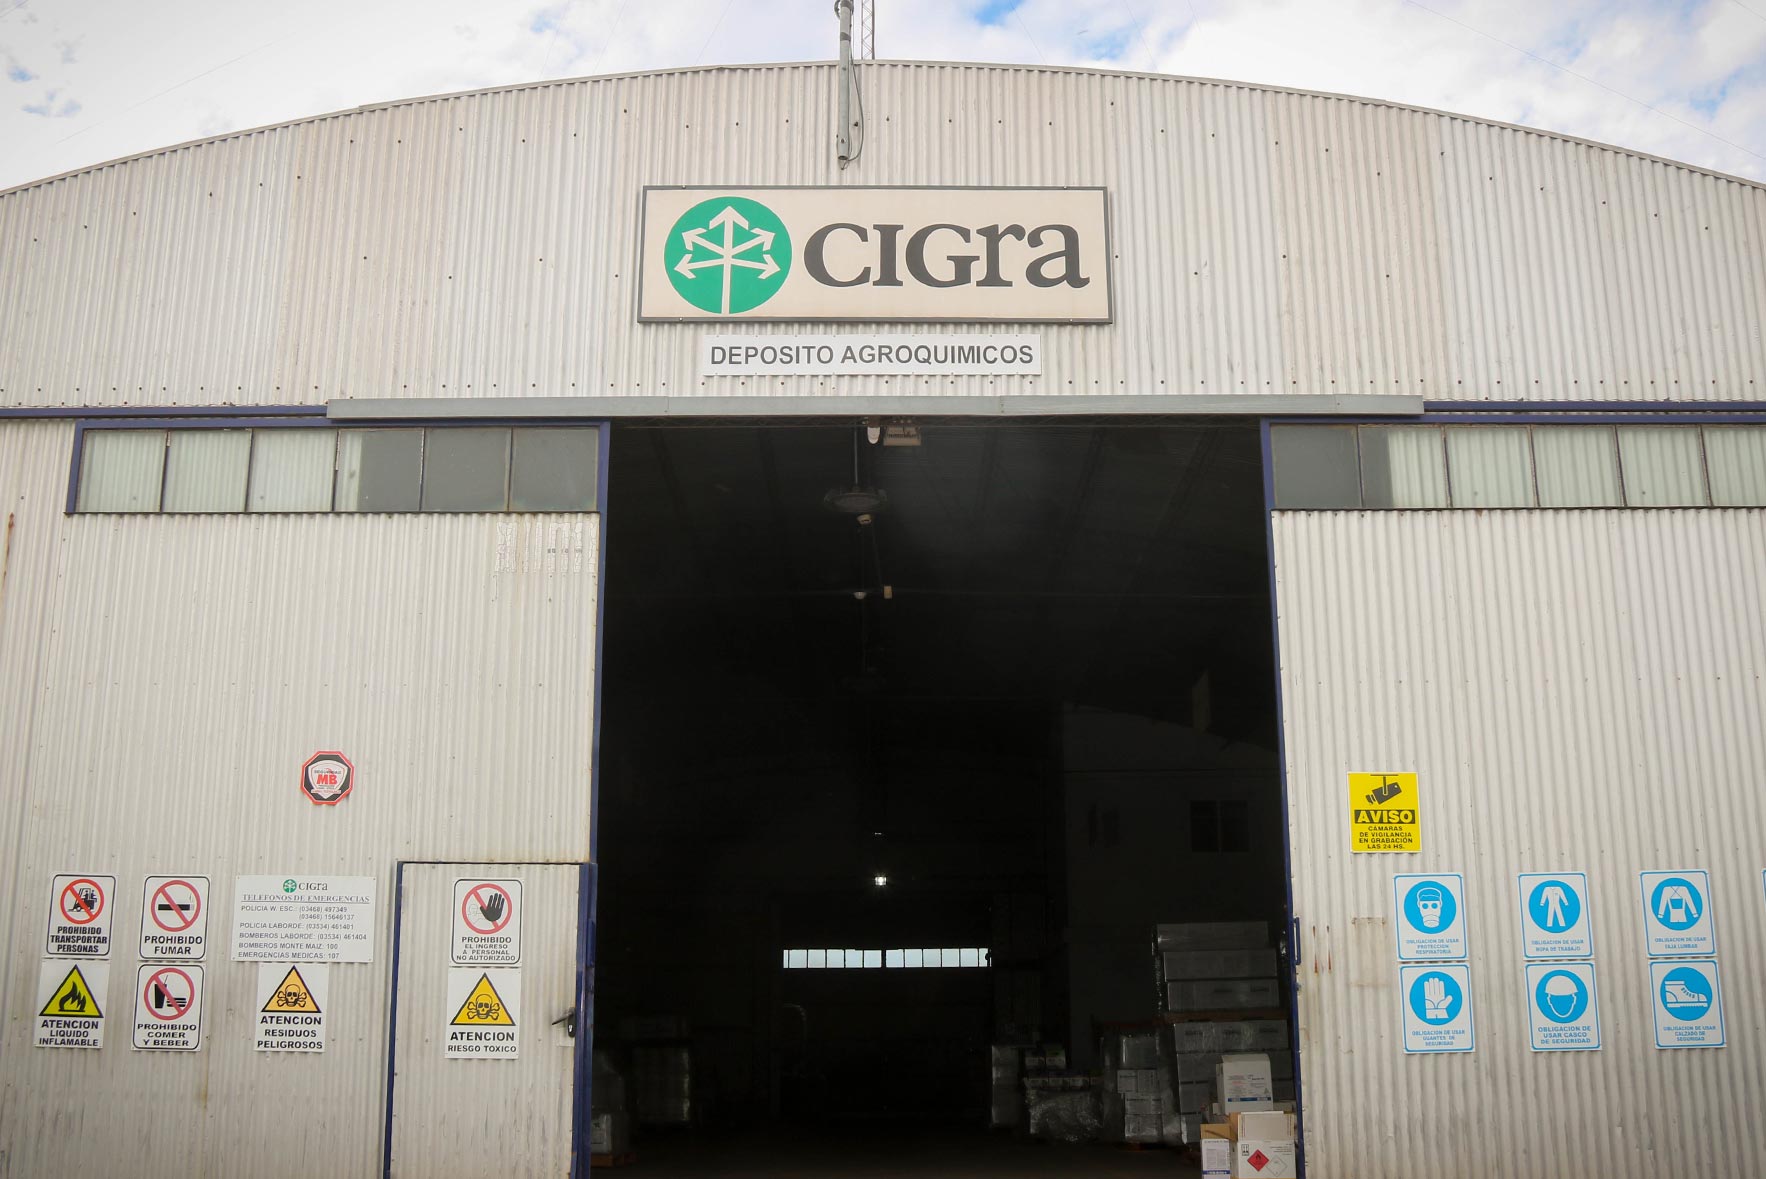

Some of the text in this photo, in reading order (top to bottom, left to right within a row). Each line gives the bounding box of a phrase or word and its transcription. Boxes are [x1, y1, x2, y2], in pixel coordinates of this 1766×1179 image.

[803, 222, 1090, 289] CIGra
[711, 344, 1034, 366] DEPOSITO AGROQUIMICOS
[317, 774, 337, 784] MB
[1358, 811, 1412, 823] AVISO
[298, 882, 328, 890] CIGra
[58, 926, 102, 935] PROHIBIDO
[50, 935, 107, 944] TRANSPORTAR
[144, 936, 202, 944] PROHIBIDO
[57, 944, 98, 952] PERSONAS
[154, 946, 191, 955] FUMAR
[41, 1020, 98, 1029] ATENCION
[260, 1016, 322, 1025] ATENCION
[264, 1029, 317, 1038] RESIDUOS
[450, 1032, 514, 1041] ATENCION
[39, 1038, 98, 1046] INFLAMABLE
[257, 1040, 323, 1049] PELIGROSOS
